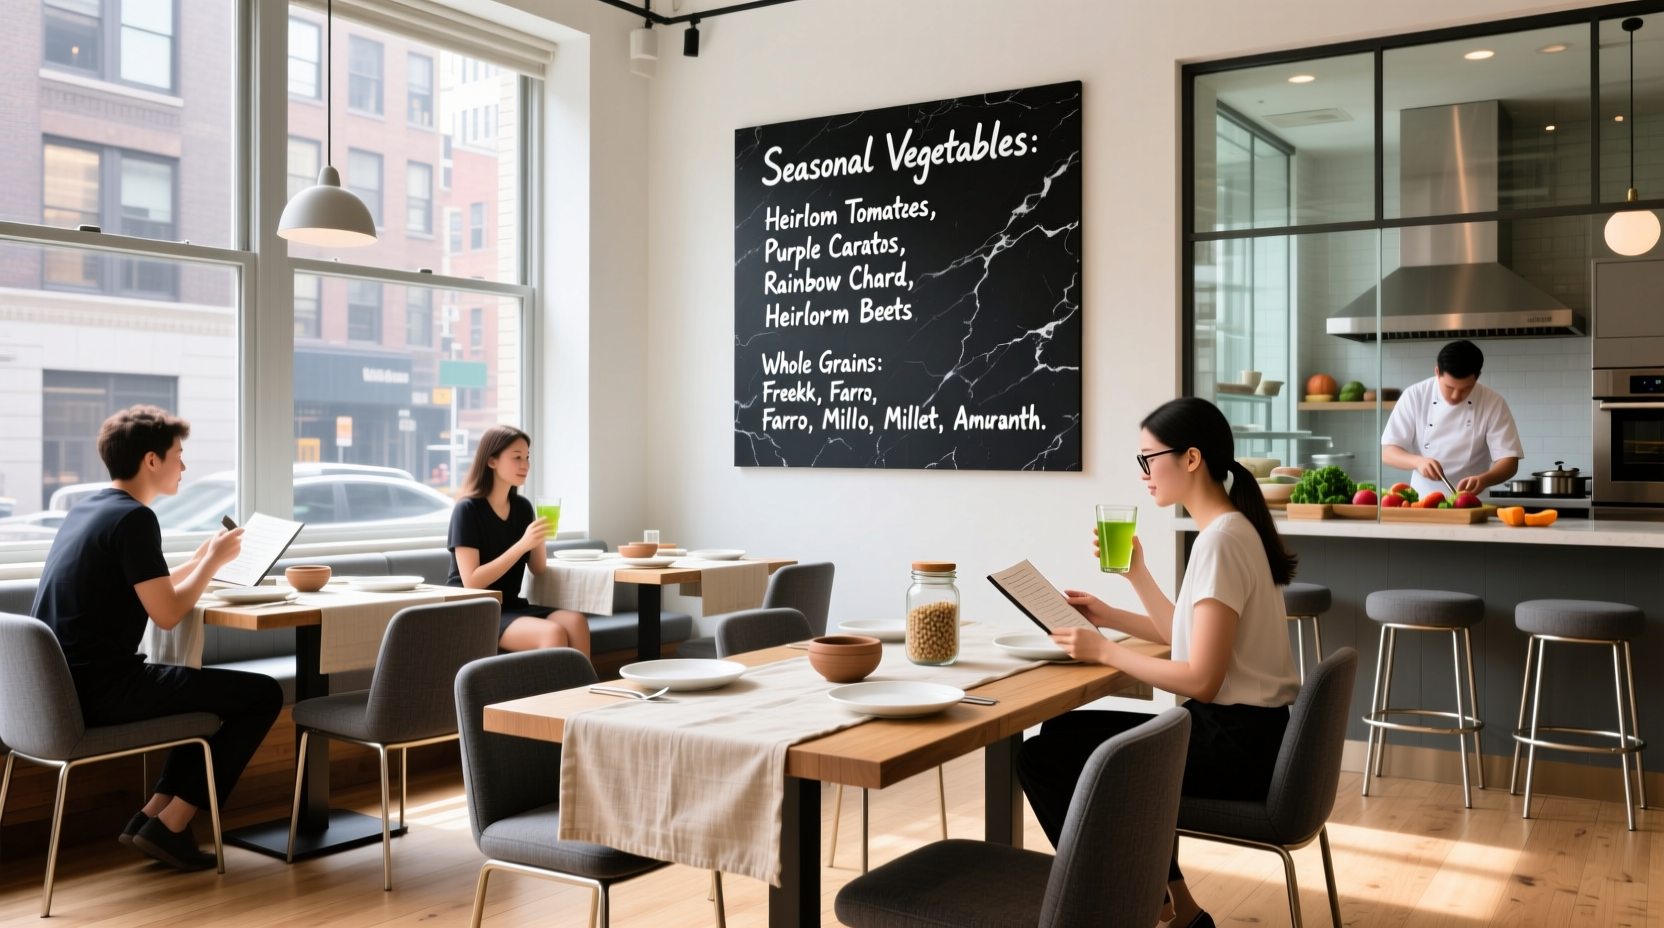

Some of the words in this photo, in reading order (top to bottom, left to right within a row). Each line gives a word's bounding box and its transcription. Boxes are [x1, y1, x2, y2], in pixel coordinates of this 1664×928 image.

[761, 135, 875, 187] Seasonal
[886, 119, 1038, 186] Vegetables:
[764, 203, 838, 232] Heirlom
[764, 236, 821, 271] Purple
[828, 230, 906, 259] Caratos,
[764, 266, 842, 296] Rainbow
[848, 260, 914, 291] Chard,
[761, 350, 812, 376] Whole
[818, 349, 883, 375] Grains:
[761, 380, 823, 406] Freekk,
[829, 379, 878, 406] Farro,
[761, 407, 814, 435] Farro,
[821, 406, 874, 435] Millo,
[883, 404, 944, 435] Millet,
